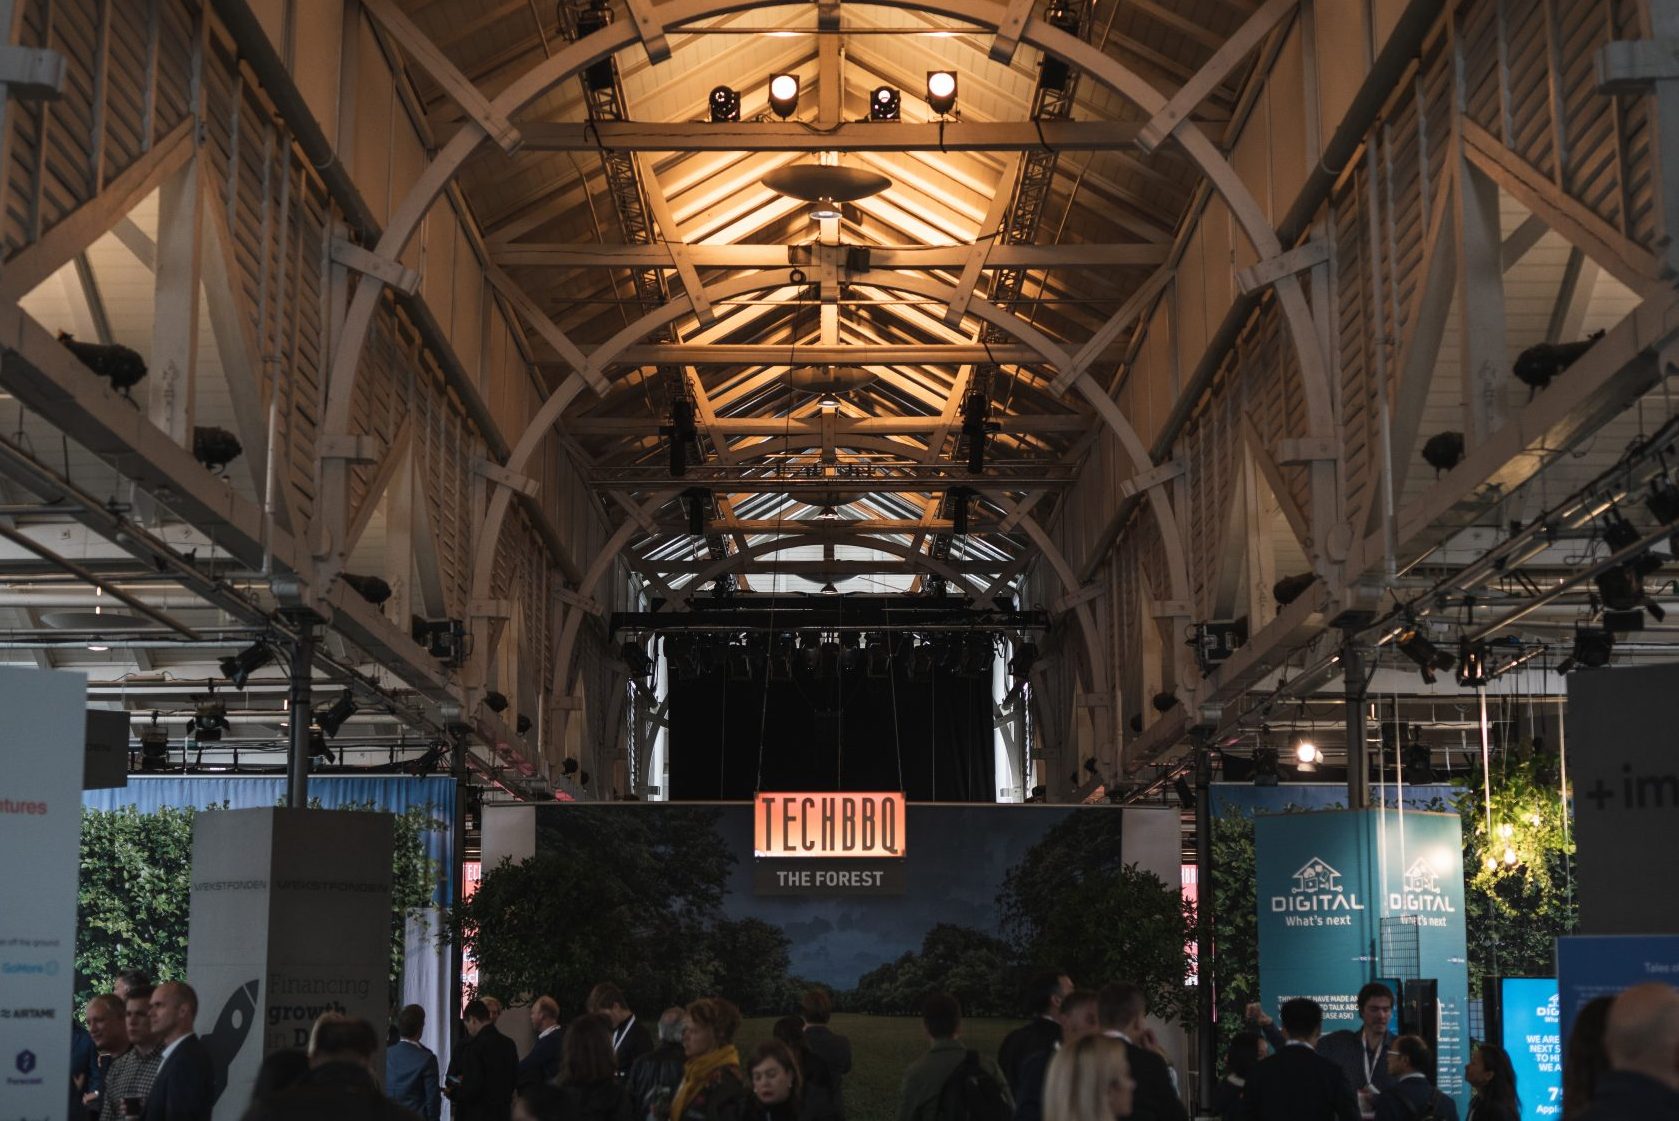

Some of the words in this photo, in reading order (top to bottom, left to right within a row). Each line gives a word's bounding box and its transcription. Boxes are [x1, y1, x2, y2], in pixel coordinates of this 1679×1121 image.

[762, 797, 899, 854] TECHBBQ
[777, 871, 811, 887] THE
[815, 871, 884, 887] FOREST
[1271, 893, 1365, 912] DIGITAL
[1389, 893, 1455, 913] DIGITAL
[1285, 914, 1323, 927] What's
[1326, 915, 1352, 926] next
[1429, 916, 1447, 927] next
[270, 974, 370, 1000] Financing
[1331, 995, 1350, 1003] MADE
[1328, 1003, 1345, 1011] TALK
[1536, 1007, 1559, 1017] DIG
[1526, 1035, 1541, 1044] WE
[1541, 1035, 1560, 1044] ARE
[1529, 1044, 1553, 1053] NEXT
[1535, 1054, 1549, 1063] TO
[1538, 1063, 1551, 1072] WE
